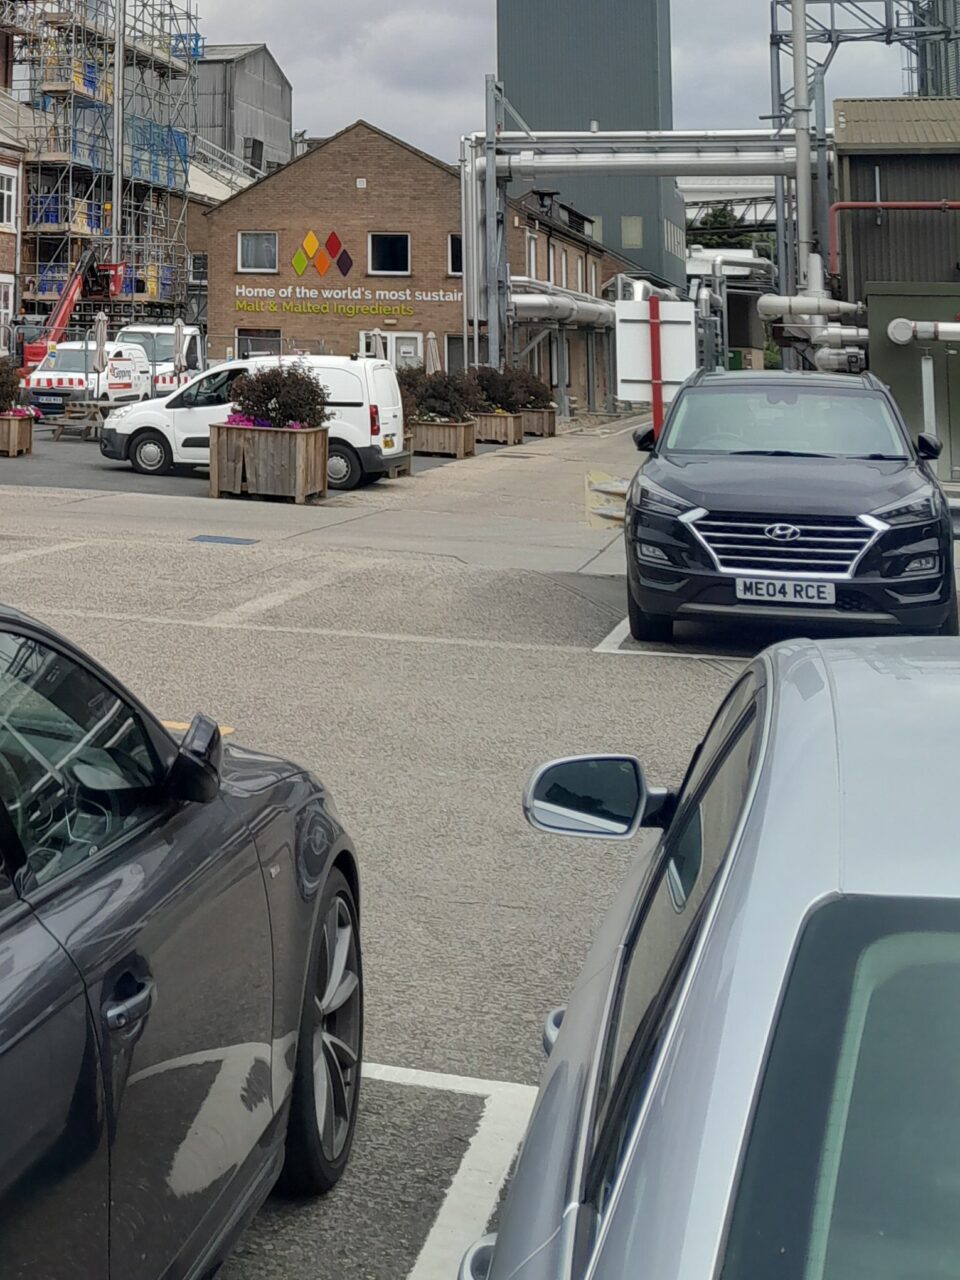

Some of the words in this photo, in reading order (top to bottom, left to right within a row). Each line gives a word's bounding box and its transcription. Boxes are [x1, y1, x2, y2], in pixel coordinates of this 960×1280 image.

[235, 285, 276, 297] Home
[279, 285, 294, 298] of
[296, 286, 319, 298] the
[321, 287, 372, 300] world's
[375, 288, 412, 301] most
[235, 300, 265, 312] Malt
[268, 301, 278, 312] &
[282, 301, 330, 313] Malted
[333, 302, 414, 317] Ingredients
[743, 581, 788, 598] ME04
[793, 583, 827, 600] RCE
